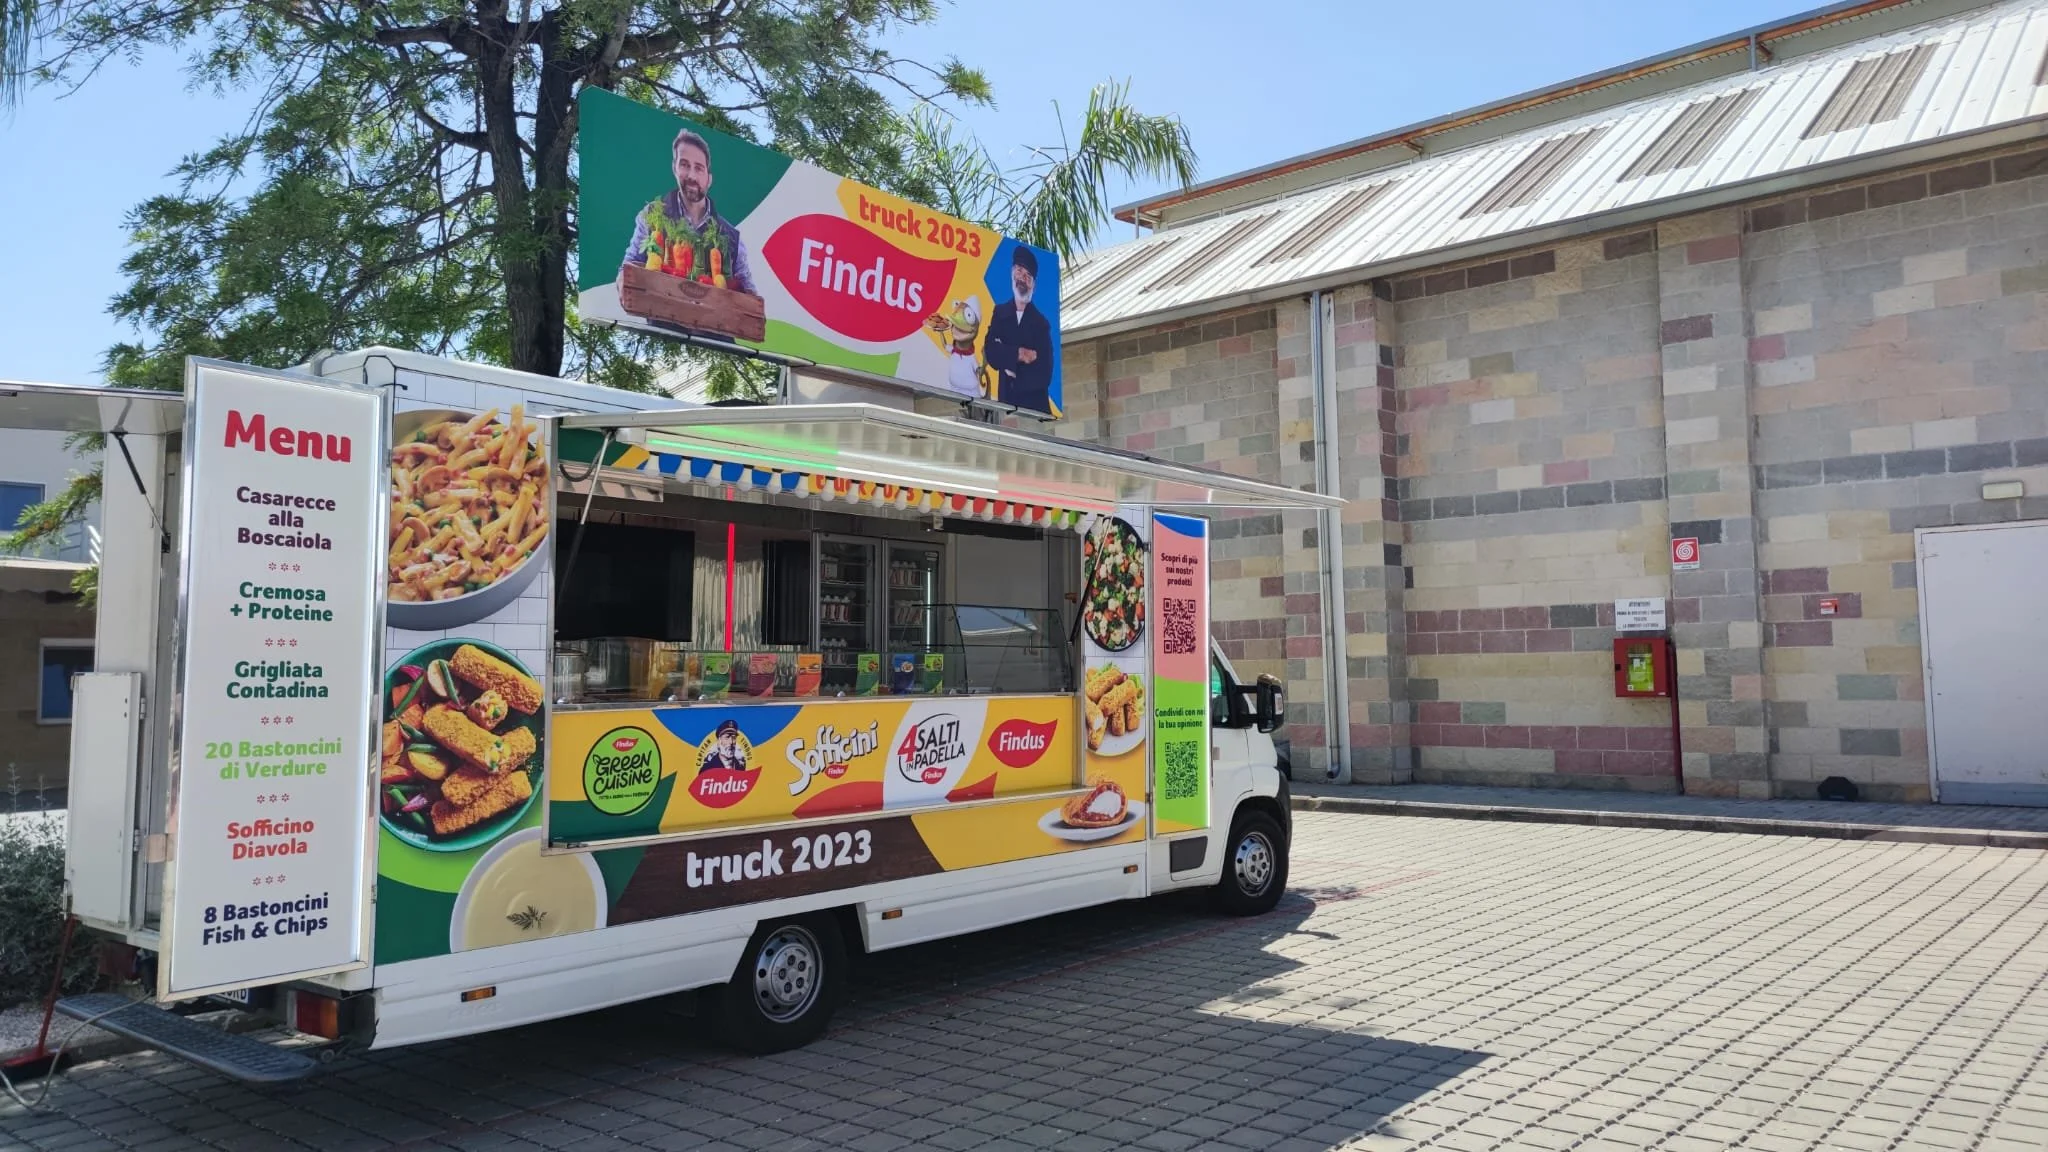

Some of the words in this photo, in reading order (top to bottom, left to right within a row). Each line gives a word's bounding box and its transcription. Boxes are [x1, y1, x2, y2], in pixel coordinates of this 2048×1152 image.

[859, 194, 922, 239] truck
[926, 217, 981, 258] 2023
[798, 237, 923, 313] Findus
[224, 410, 352, 463] Menu
[236, 486, 336, 511] Casarecce
[268, 510, 304, 528] alla
[237, 527, 332, 550] Boscaiola
[1160, 552, 1181, 567] Scopri
[1182, 554, 1188, 563] di
[1167, 576, 1193, 586] prodotti
[1176, 566, 1194, 575] nostri
[239, 581, 326, 601] Cremosa
[230, 603, 243, 617] +
[249, 602, 333, 621] Proteine
[234, 660, 323, 682] Grigliata
[226, 681, 329, 698] Contadina
[1155, 707, 1184, 717] Condividi
[1158, 719, 1164, 728] la
[1165, 719, 1176, 728] tua
[1177, 718, 1203, 731] opinione
[205, 742, 233, 759] 20
[239, 737, 342, 757] Bastoncini
[616, 740, 634, 749] Findus
[897, 724, 918, 763] 4
[916, 720, 960, 752] SALTI
[999, 731, 1045, 751] Findus
[785, 720, 879, 796] Sofficini
[906, 763, 914, 772] IN
[914, 742, 966, 771] PADELLA
[220, 762, 239, 779] di
[246, 759, 327, 778] Verdure
[700, 775, 749, 796] Findus
[227, 817, 314, 839] Sofficino
[232, 838, 308, 859] Diavola
[686, 839, 785, 888] truck
[791, 829, 872, 873] 2023
[204, 906, 217, 923] 8
[223, 891, 329, 921] Bastoncini
[203, 924, 245, 945] Fish
[251, 921, 269, 939] &
[274, 914, 328, 936] Chips
